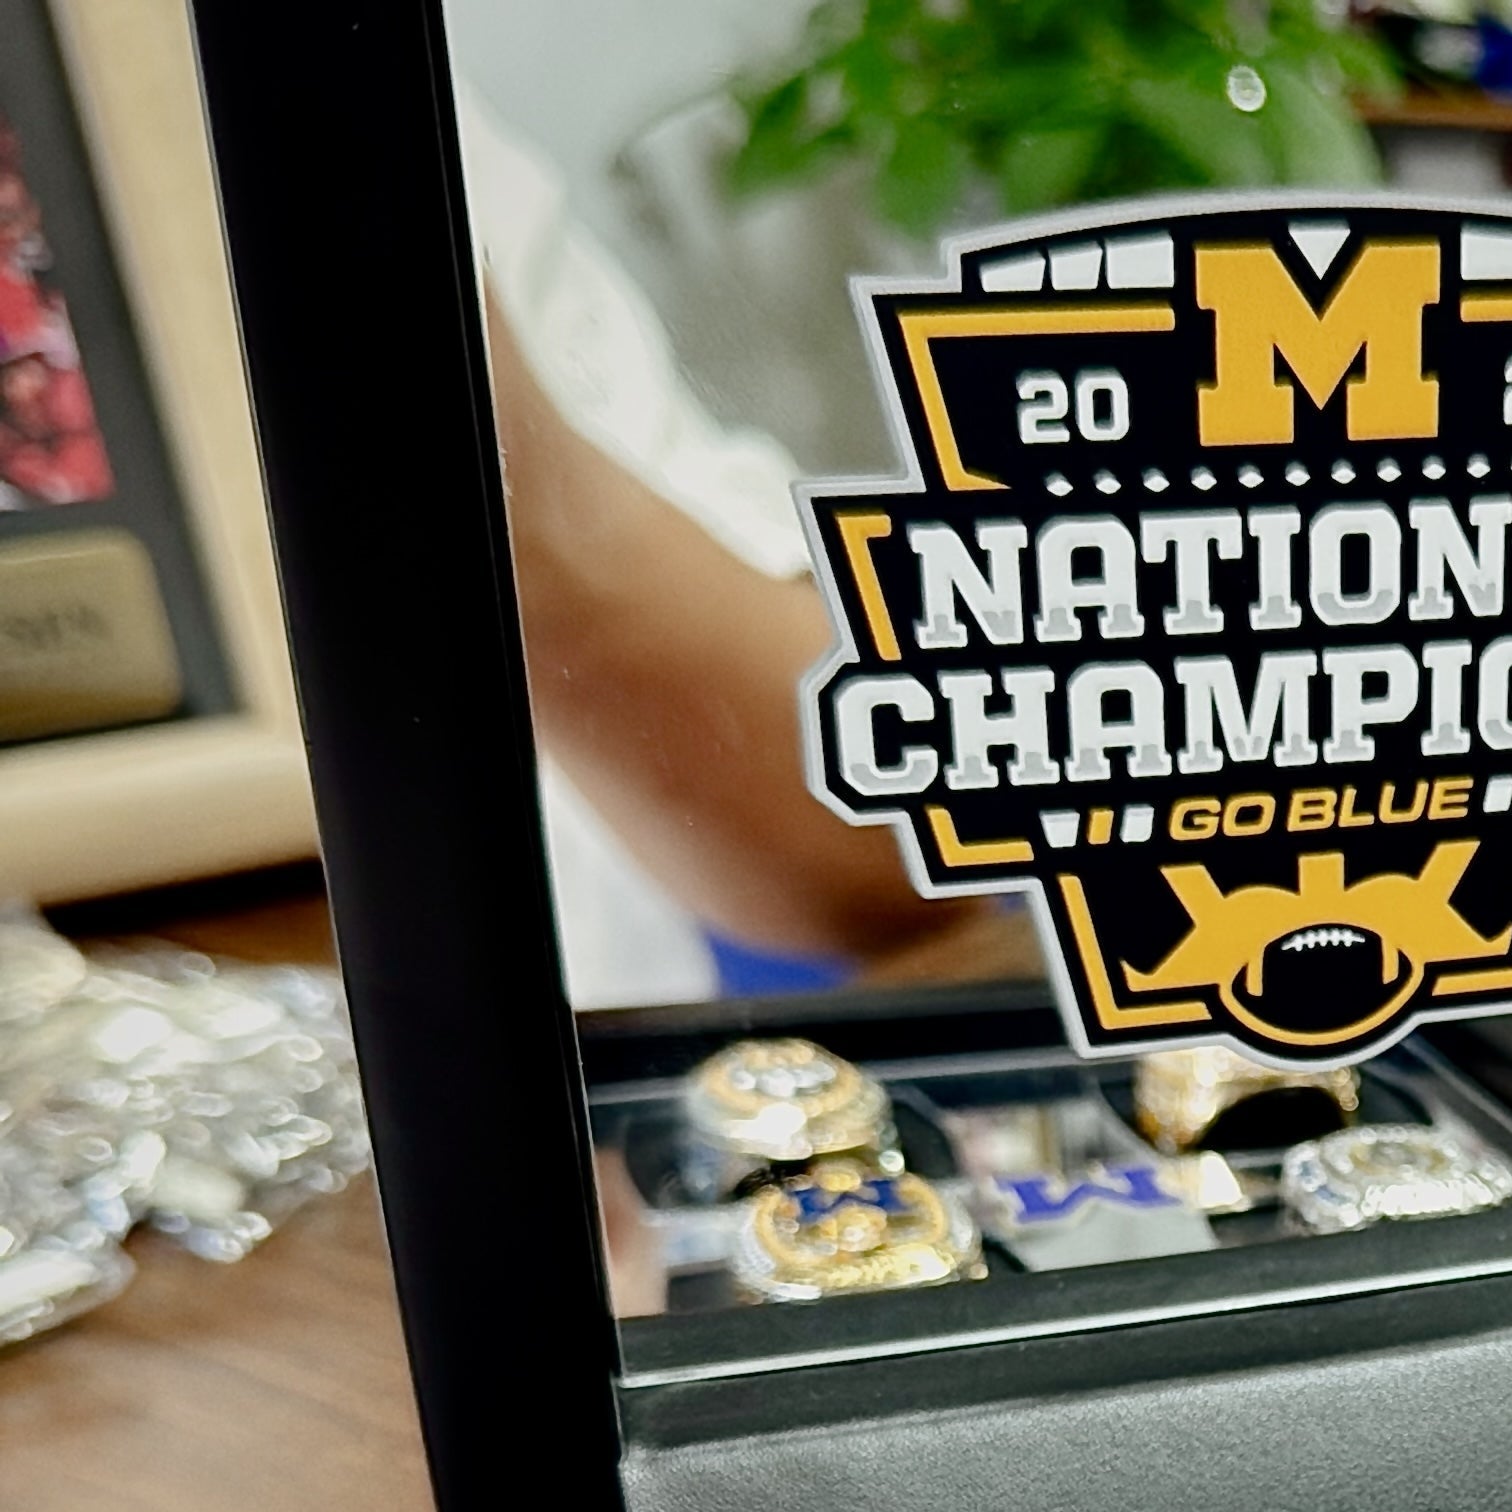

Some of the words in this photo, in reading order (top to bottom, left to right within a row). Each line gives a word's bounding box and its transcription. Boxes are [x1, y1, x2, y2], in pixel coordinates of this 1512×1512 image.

[1195, 243, 1440, 447] M
[1018, 368, 1131, 443] 20
[1168, 795, 1275, 840] GO
[1286, 777, 1474, 833] BLUE
